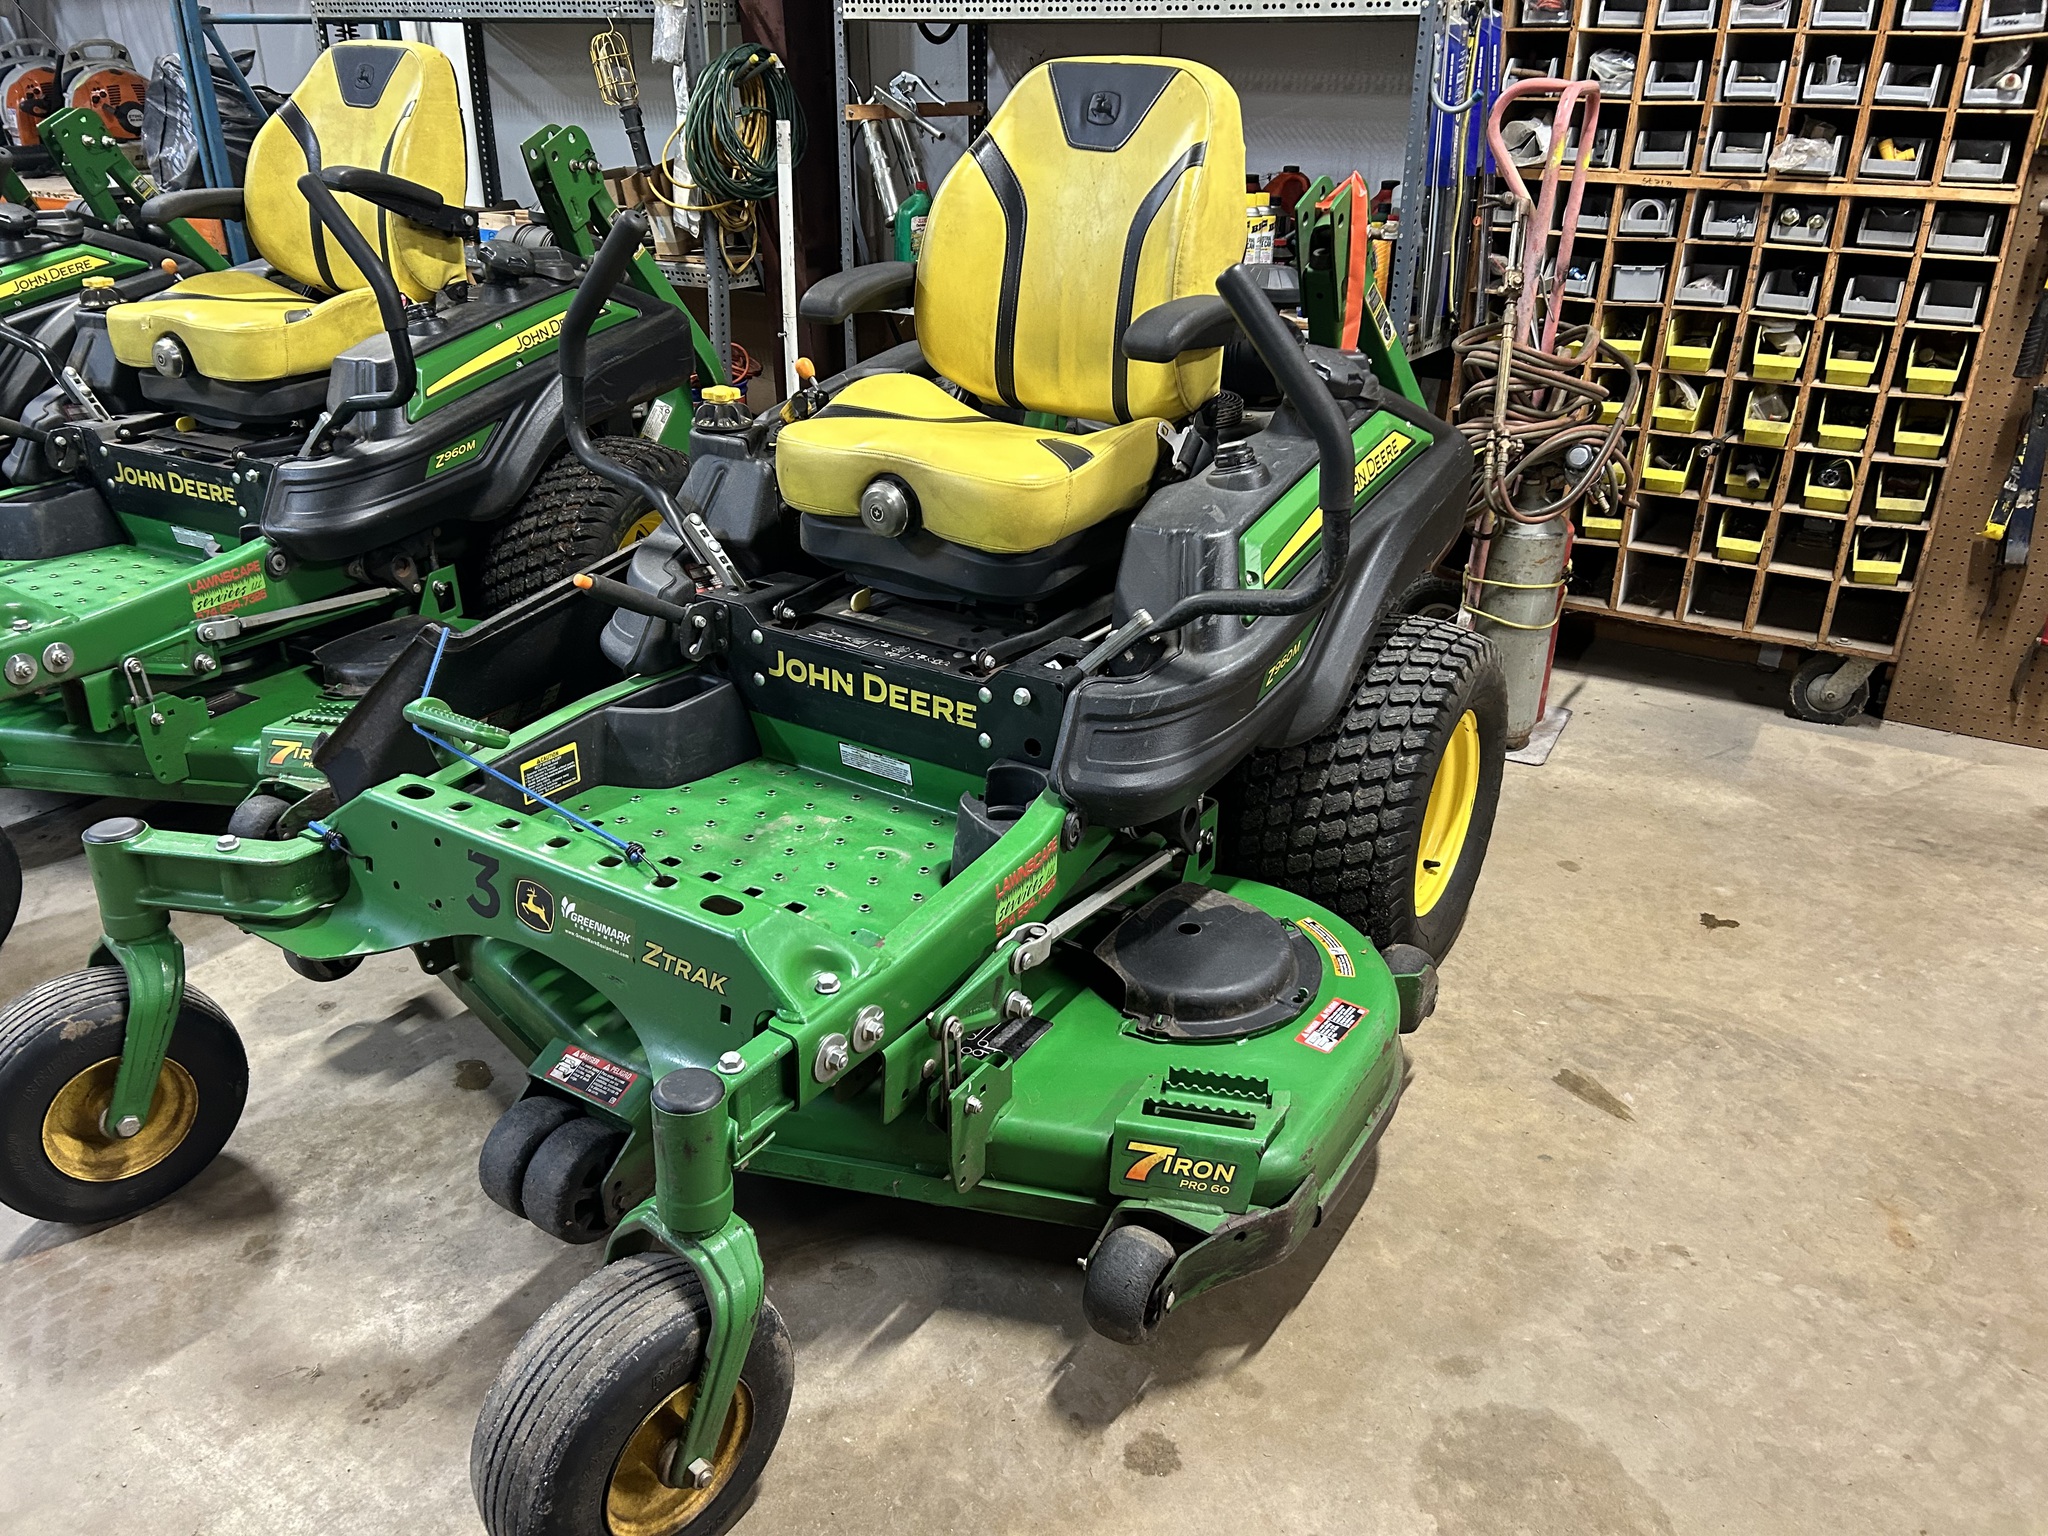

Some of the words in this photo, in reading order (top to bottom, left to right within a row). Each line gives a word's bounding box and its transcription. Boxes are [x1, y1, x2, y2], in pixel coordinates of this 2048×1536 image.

[13, 273, 48, 294] JOHN
[48, 259, 93, 281] DEERE
[516, 326, 550, 351] JOHN
[435, 439, 476, 469] Z960M
[1366, 439, 1399, 478] DEERE
[114, 461, 166, 492] JOHN
[167, 471, 238, 506] DEERE
[187, 560, 262, 595] LAWNSCAPE
[197, 586, 247, 611] services
[768, 650, 854, 697] JOHN
[863, 671, 978, 729] DEERE
[293, 747, 313, 760] IR
[466, 848, 501, 919] 3
[995, 834, 1058, 901] LAWNSCAPE
[570, 912, 631, 944] GREENMARK
[574, 923, 626, 947] EQUIPMENT
[641, 941, 730, 996] ZTRAK
[1179, 1179, 1208, 1192] PRO
[1210, 1184, 1230, 1194] 60
